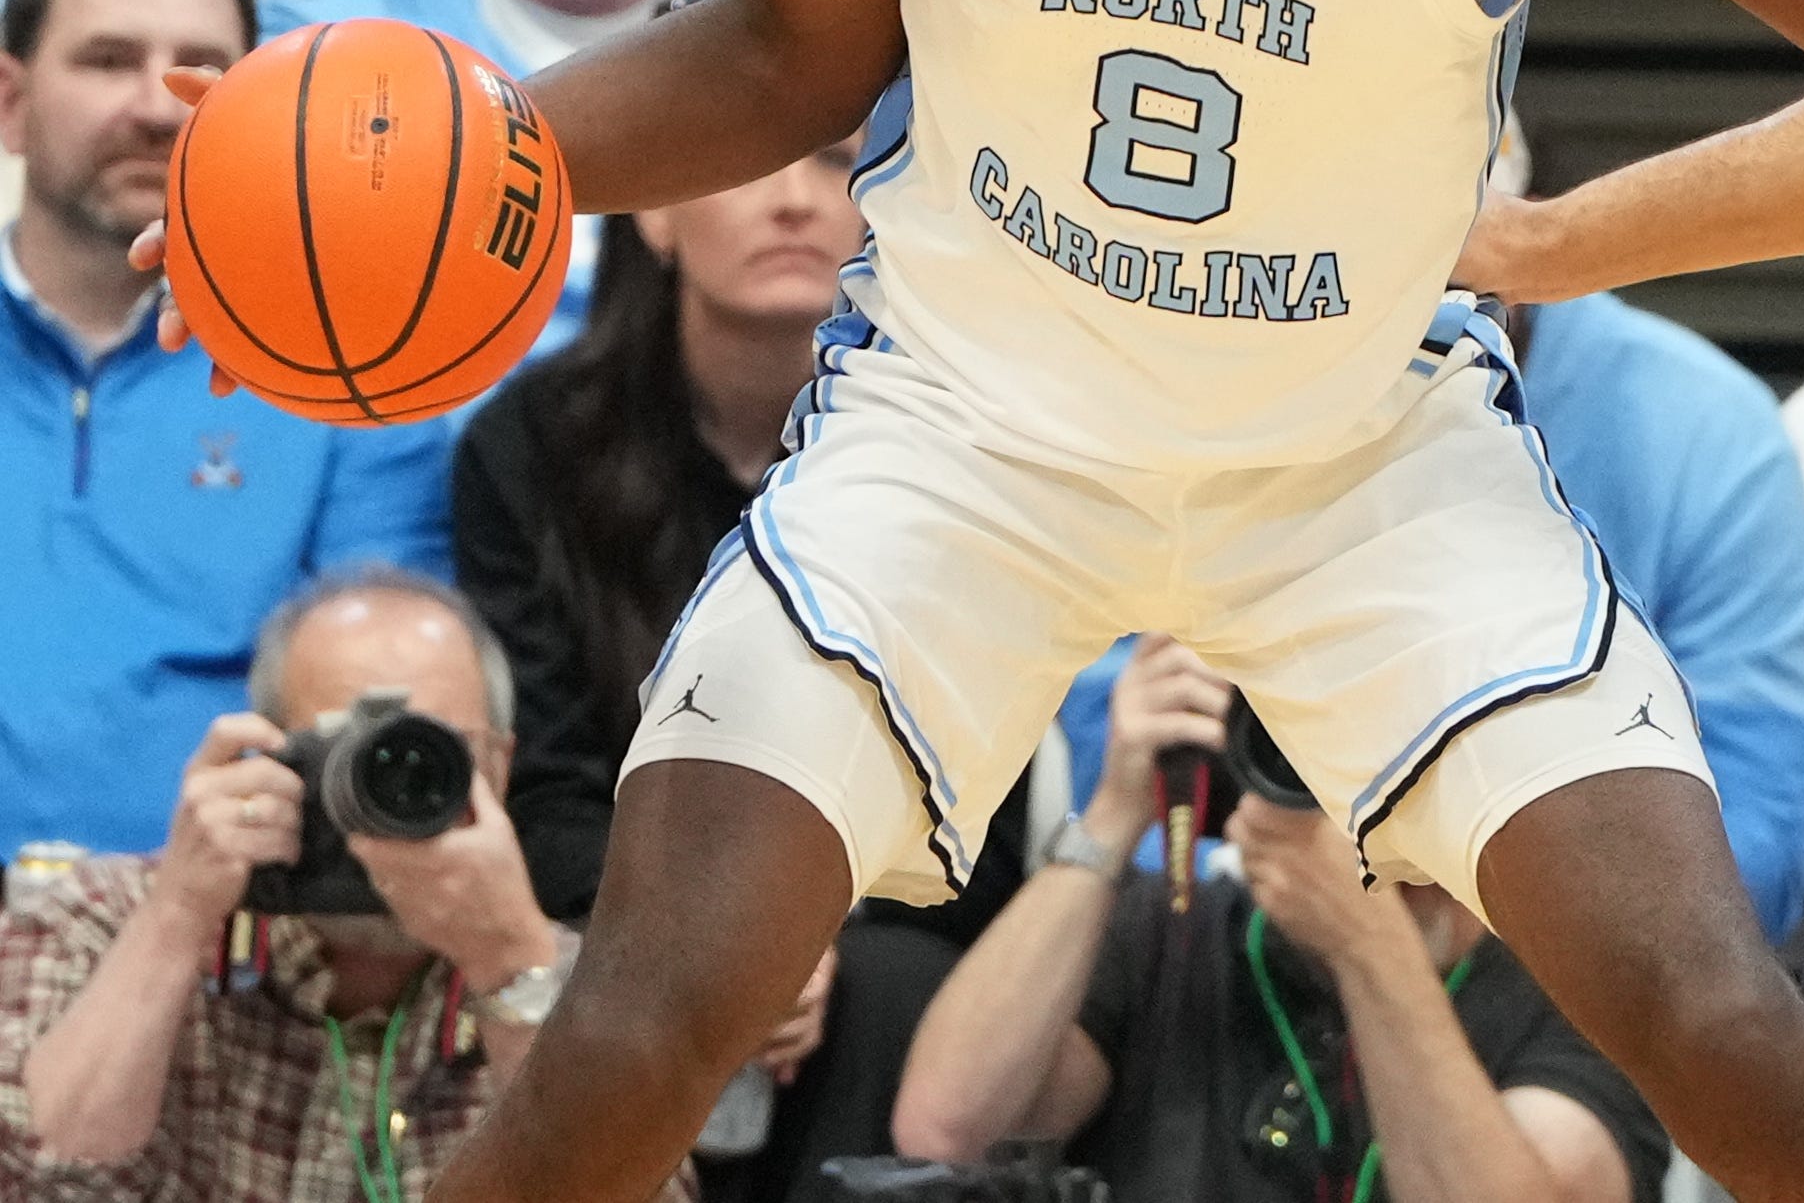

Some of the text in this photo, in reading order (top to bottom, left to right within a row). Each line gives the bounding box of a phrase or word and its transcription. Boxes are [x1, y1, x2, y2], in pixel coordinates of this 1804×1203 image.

[486, 73, 542, 271] ELITE
[1084, 48, 1243, 224] 8
[970, 147, 1350, 321] CAROLINA
